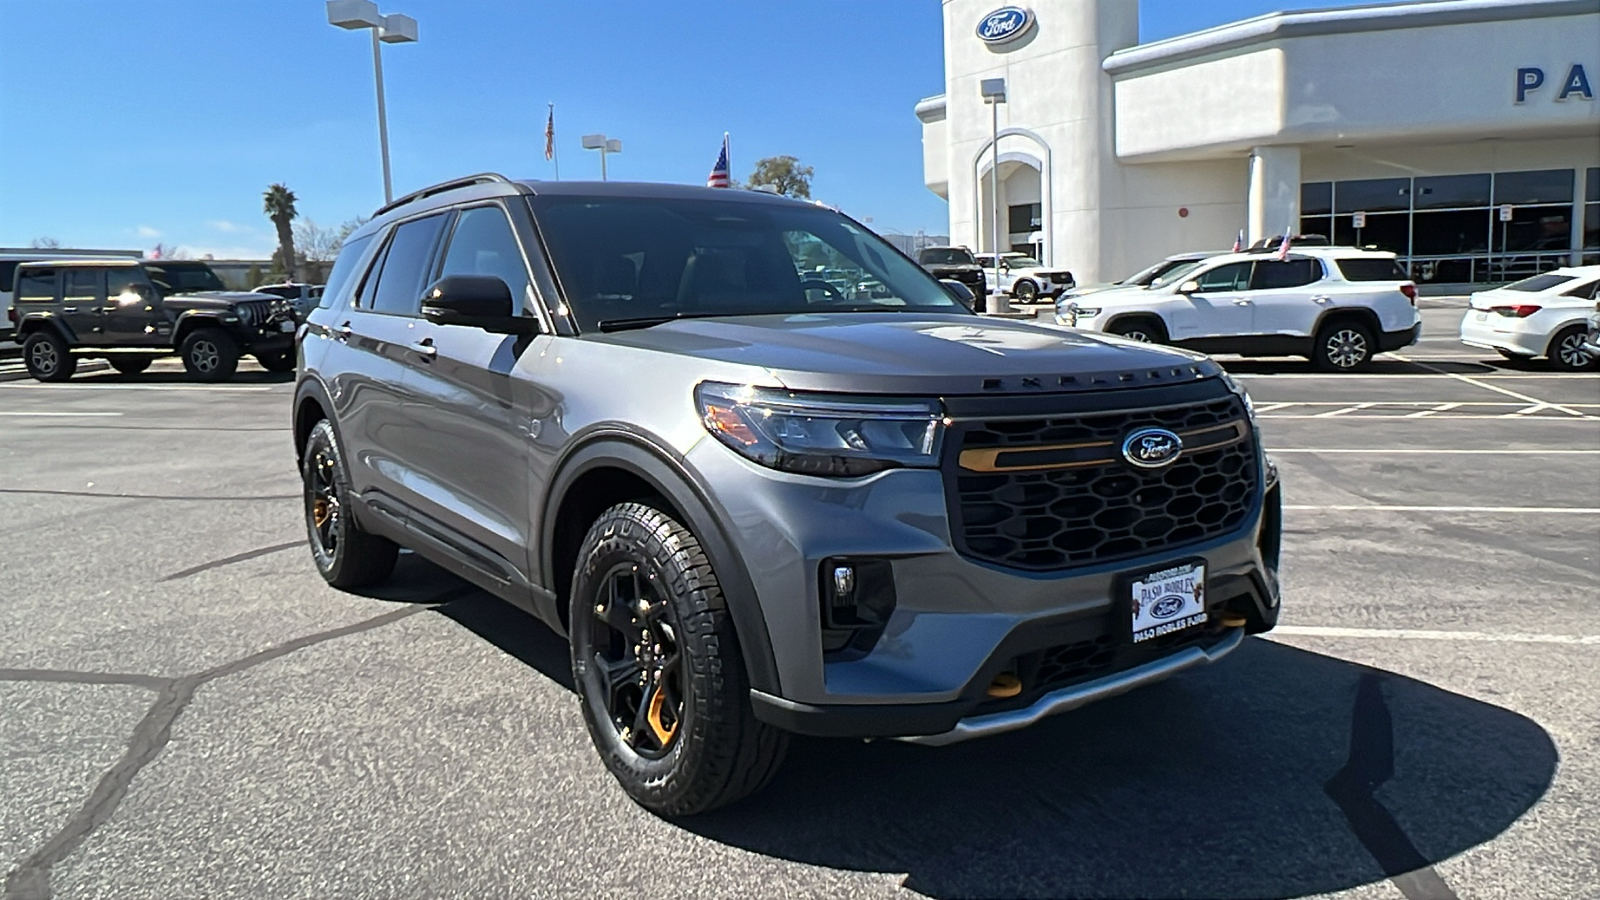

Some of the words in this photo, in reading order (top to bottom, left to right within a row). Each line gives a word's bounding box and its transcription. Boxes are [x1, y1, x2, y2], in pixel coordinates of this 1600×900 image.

[984, 12, 1017, 37] Ford
[1516, 64, 1593, 103] PA
[1140, 436, 1172, 459] Ford
[1141, 585, 1162, 607] PASO
[1163, 577, 1194, 594] ROBLES
[1156, 599, 1179, 615] Ford
[1133, 628, 1155, 643] PASO
[1155, 619, 1187, 637] ROBLES
